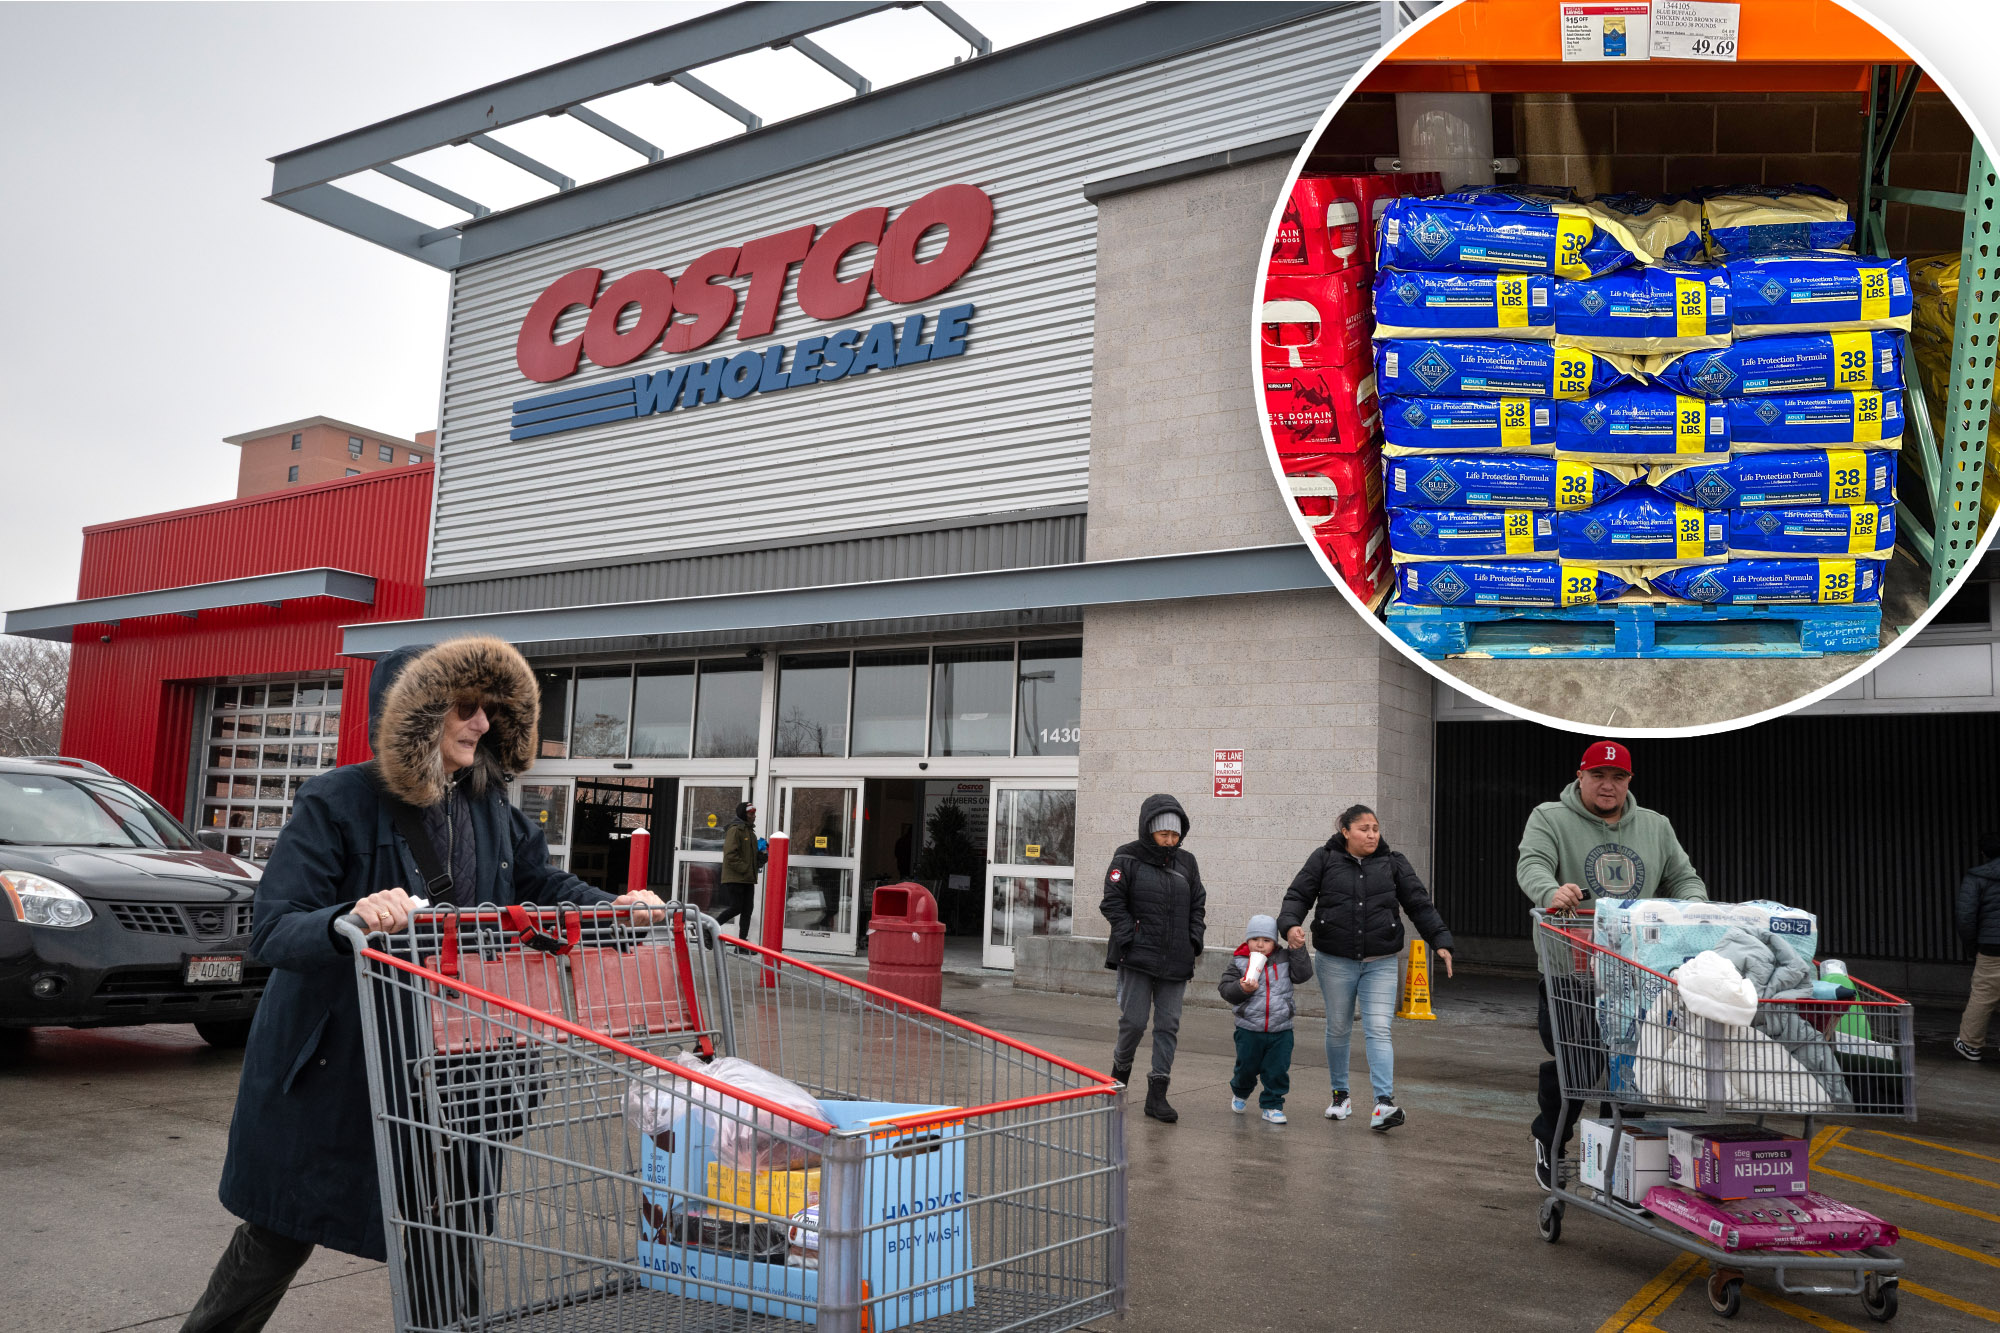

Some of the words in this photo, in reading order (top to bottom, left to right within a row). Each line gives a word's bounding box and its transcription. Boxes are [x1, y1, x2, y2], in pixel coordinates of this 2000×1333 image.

[1692, 39, 1734, 54] 49.69
[1461, 223, 1476, 232] Life
[1562, 232, 1586, 251] 38
[516, 184, 994, 382] COSTCO
[1866, 274, 1884, 287] 38
[1502, 282, 1522, 295] 38
[1866, 288, 1885, 298] LBS.
[1502, 297, 1523, 306] LBS.
[1681, 291, 1701, 304] 38
[1682, 306, 1702, 315] LBS.
[633, 304, 975, 416] WHOLESALE
[1477, 356, 1514, 365] Protection
[1517, 358, 1547, 366] Formula
[1757, 356, 1795, 365] Protection
[1840, 350, 1866, 369] 38
[1560, 361, 1586, 378] 38
[1840, 370, 1867, 383] LBS.
[1560, 381, 1586, 392] LBS.
[1505, 404, 1524, 417] 38
[1859, 398, 1877, 411] 38
[1506, 418, 1526, 426] LBS.
[1682, 411, 1700, 424] 38
[1858, 412, 1878, 421] LBS.
[1681, 426, 1701, 434] LBS.
[1755, 473, 1792, 481] Protection
[1835, 469, 1860, 486] 38
[1562, 476, 1587, 492] 38
[1835, 488, 1860, 499] LBS.
[1509, 515, 1528, 526] 38
[1681, 519, 1699, 532] 38
[1855, 513, 1873, 525] 38
[1509, 527, 1529, 536] LBS.
[1490, 574, 1524, 583] Protection
[1567, 577, 1591, 593] 38
[1825, 573, 1848, 590] 38
[1816, 627, 1866, 638] PROPERTY
[1040, 728, 1080, 743] 1430
[1216, 752, 1226, 760] FIRE
[1228, 752, 1242, 760] LANE
[1605, 747, 1616, 760] B
[1634, 860, 1643, 890] SUPPLY
[1772, 921, 1791, 931] 160
[201, 963, 234, 977] 40160
[648, 1164, 666, 1173] BDY
[1734, 1162, 1793, 1176] KITCHEN
[888, 1234, 922, 1253] BODY
[927, 1226, 959, 1244] WASH
